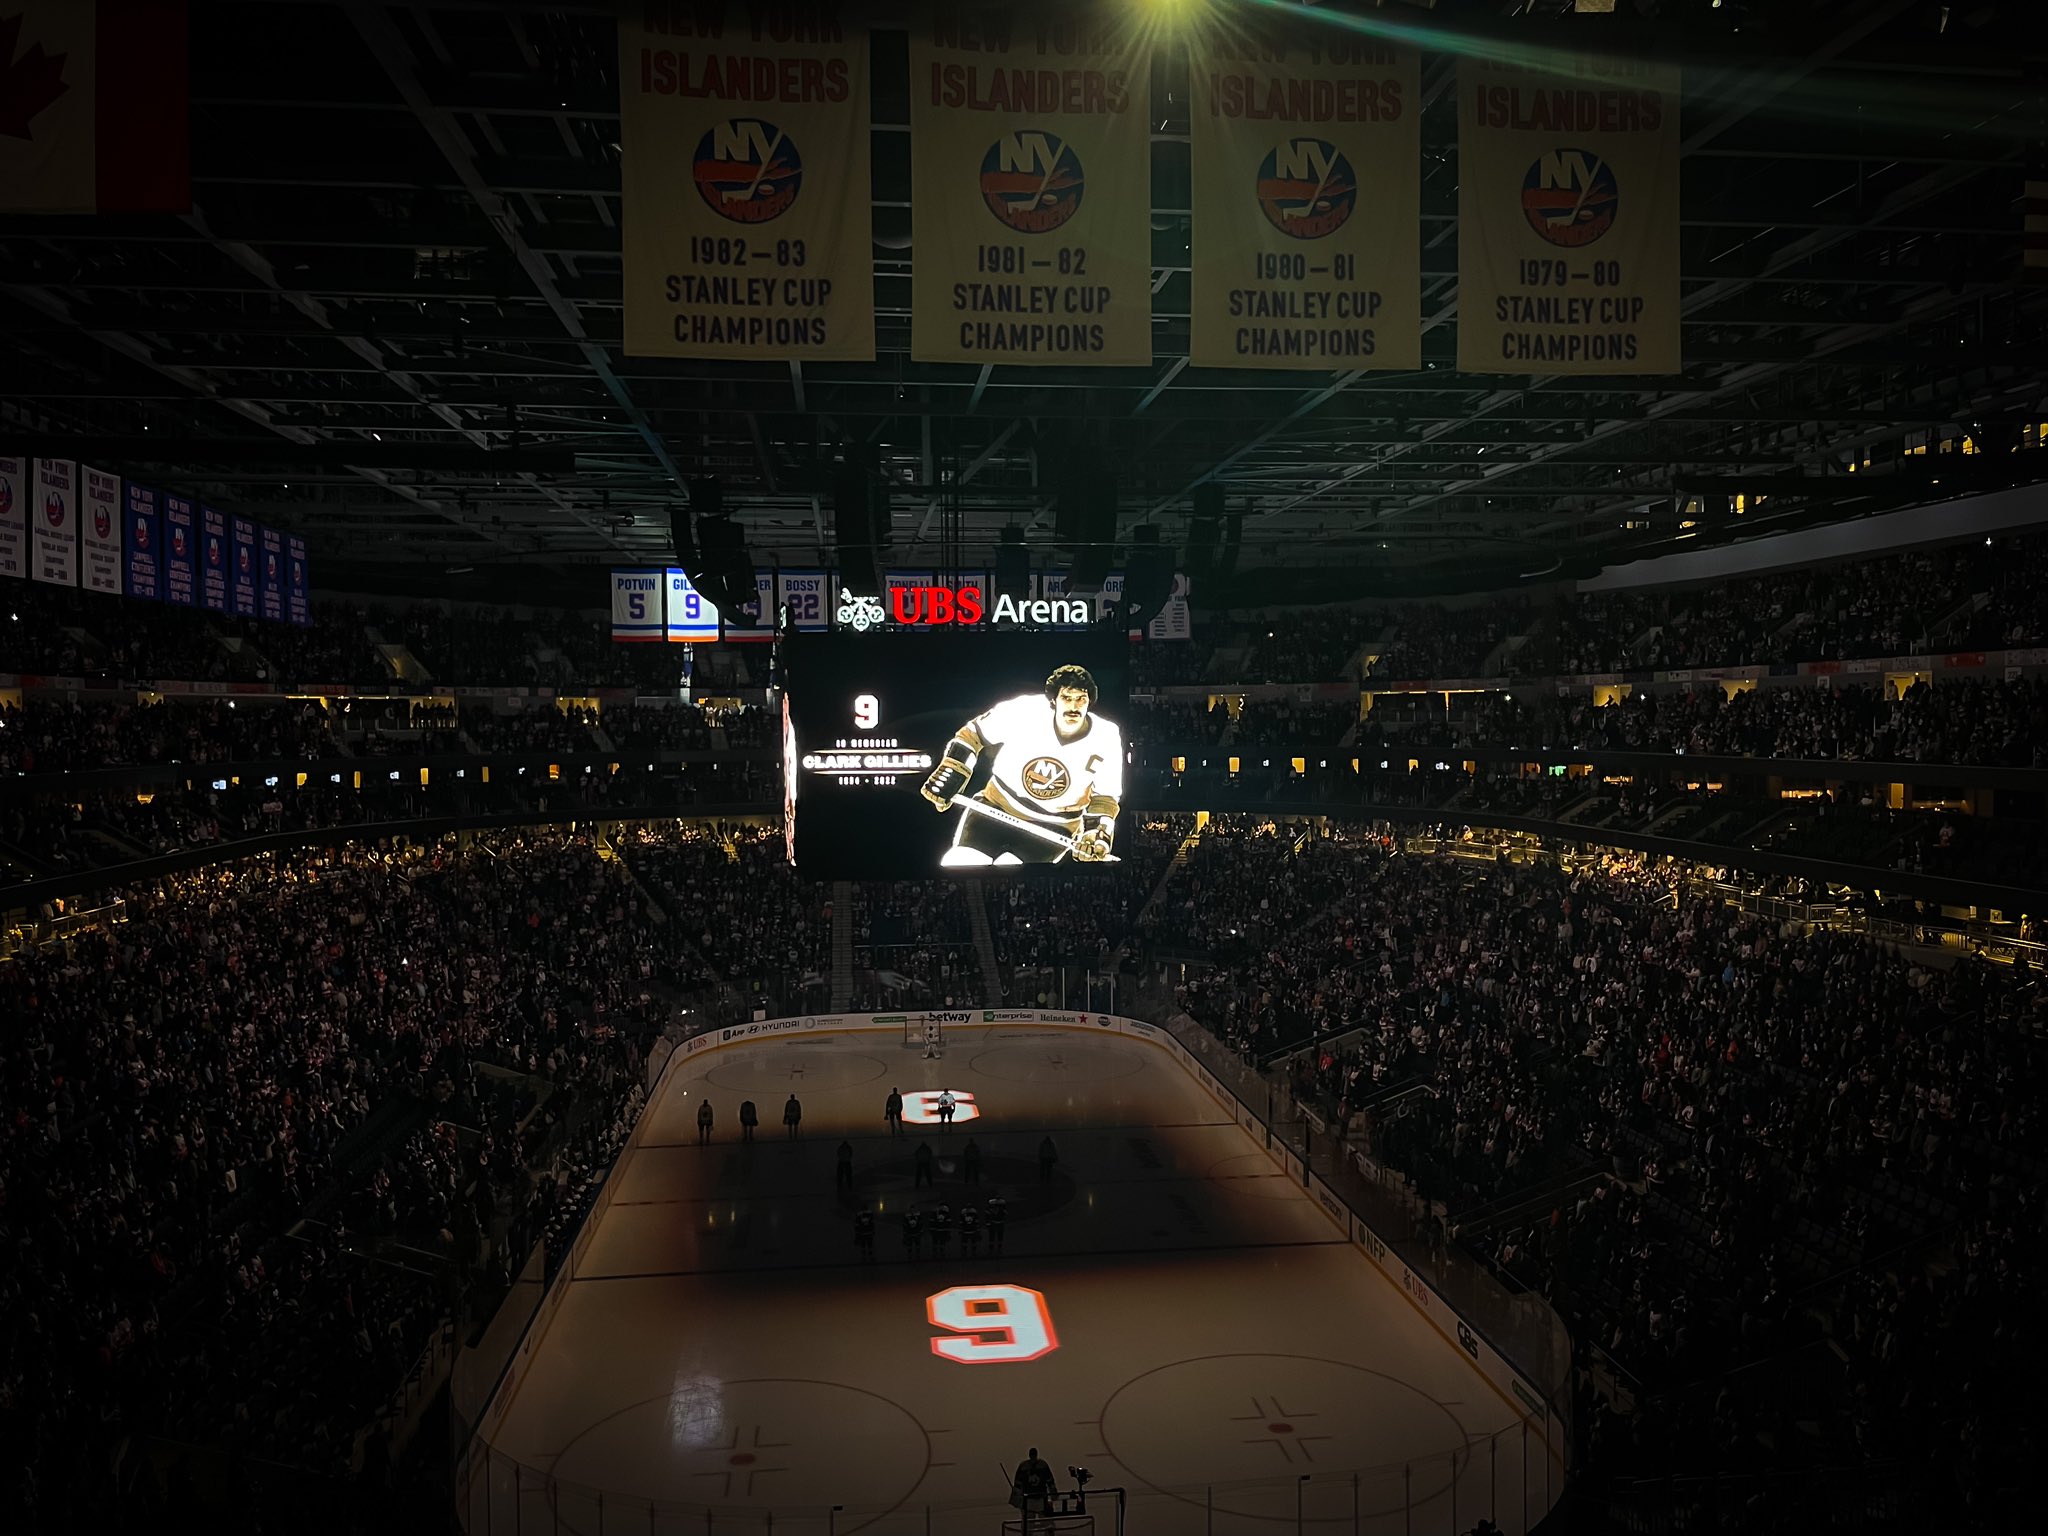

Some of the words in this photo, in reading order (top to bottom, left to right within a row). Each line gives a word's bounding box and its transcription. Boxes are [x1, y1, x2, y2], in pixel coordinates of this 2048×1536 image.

[641, 49, 849, 102] ISLANDERS
[931, 63, 1129, 114] ISLANDERS
[1210, 73, 1402, 122] ISLANDERS
[1478, 85, 1661, 132] ISLANDERS
[666, 275, 774, 306] STANLEY
[784, 278, 832, 307] CUP
[953, 283, 1056, 313] STANLEY
[1064, 286, 1110, 314] CUP
[1229, 290, 1330, 319] STANLEY
[1337, 291, 1382, 318] CUP
[1497, 296, 1593, 325] STANLEY
[1601, 297, 1643, 323] CUP
[674, 315, 826, 345] CHAMPIONS
[960, 321, 1104, 352] CHAMPIONS
[1236, 327, 1375, 356] CHAMPIONS
[1502, 332, 1637, 361] CHAMPIONS
[617, 578, 656, 590] POTVIN
[786, 579, 820, 591] BOSSY
[629, 594, 644, 619] 5
[686, 594, 701, 619] 9
[787, 594, 820, 620] 22
[889, 586, 985, 626] UBS
[991, 593, 1088, 624] Arena
[854, 694, 879, 729] 9
[803, 755, 861, 769] CLARK
[864, 755, 932, 768] GILLIES
[761, 1020, 800, 1031] HYUNDAI
[929, 1011, 972, 1024] betway
[1040, 1014, 1076, 1023] Heineken
[693, 1037, 707, 1050] UBS
[1366, 1229, 1386, 1263] NFP
[1411, 1275, 1429, 1306] UBS
[925, 1283, 1061, 1365] 9
